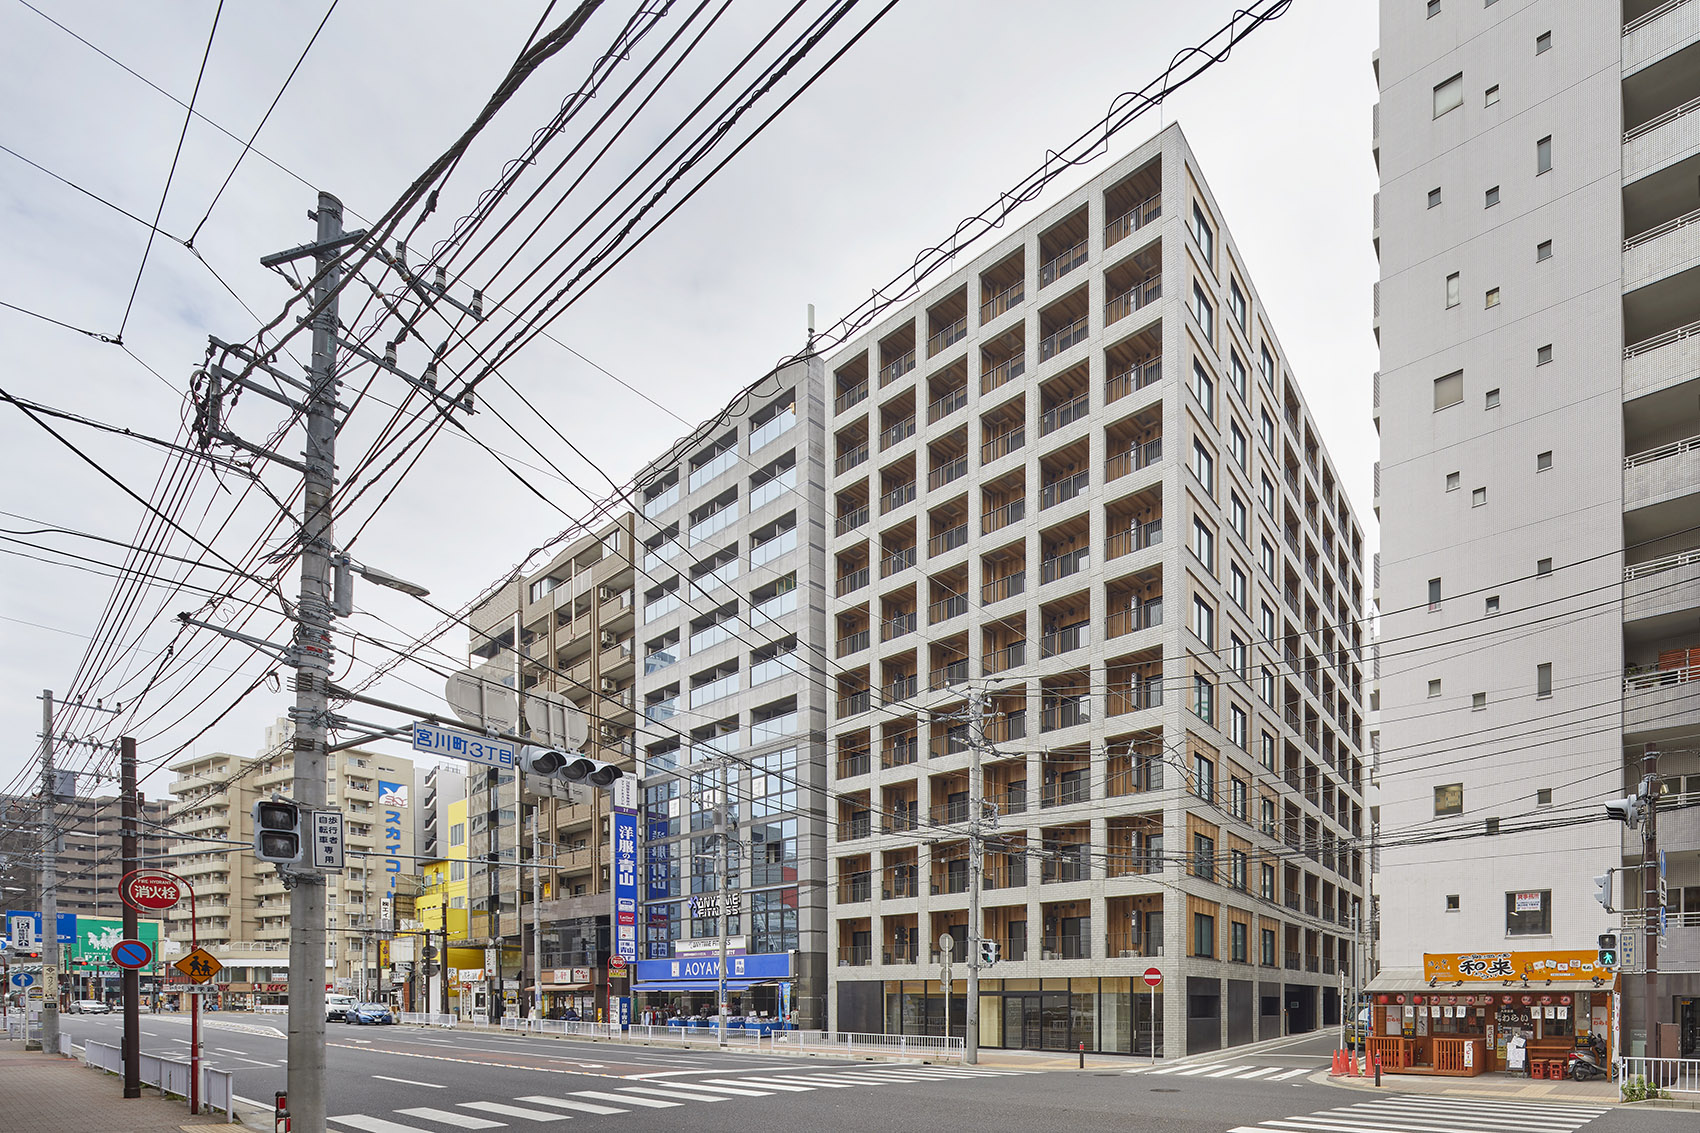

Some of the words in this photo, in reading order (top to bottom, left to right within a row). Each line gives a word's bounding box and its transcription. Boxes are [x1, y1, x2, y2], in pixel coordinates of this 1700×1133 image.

[416, 728, 512, 764] 宮川町3丁目
[318, 816, 328, 844] 自転車
[329, 816, 338, 844] 歩行者
[324, 846, 334, 864] 専用
[618, 825, 635, 886] 洋服の青山
[135, 885, 177, 900] 消火栓
[698, 892, 740, 909] ANYTME
[698, 905, 739, 917] FITNSS
[685, 961, 729, 976] AOYAM
[266, 984, 287, 992] KFC
[1502, 1014, 1529, 1022] わらい
